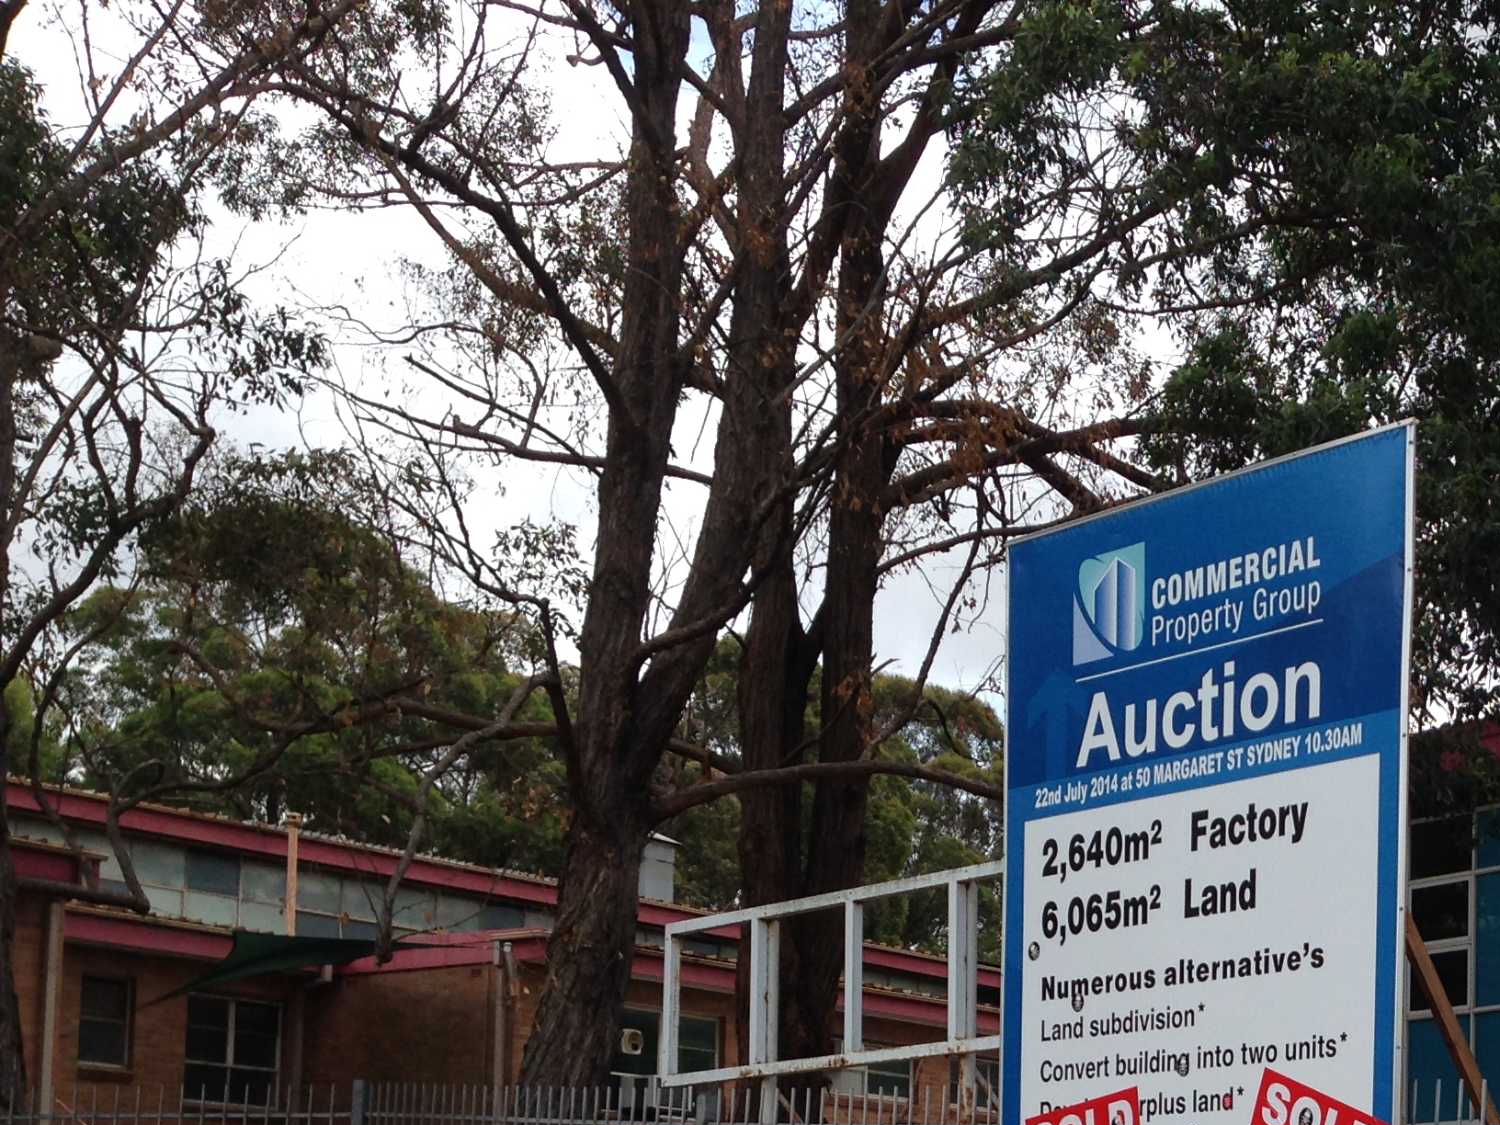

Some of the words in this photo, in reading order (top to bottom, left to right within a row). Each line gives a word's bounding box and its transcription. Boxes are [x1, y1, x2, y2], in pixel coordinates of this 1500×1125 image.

[1152, 536, 1321, 609] COMMERCIAL
[1152, 595, 1244, 646] Property
[1253, 580, 1321, 622] Group
[1076, 659, 1321, 768] Auction
[1035, 788, 1061, 809] 22nd
[1064, 783, 1088, 805] July
[1090, 779, 1118, 798] 2014
[1120, 777, 1133, 792] at
[1136, 773, 1150, 790] 50
[1154, 752, 1223, 784] MARGARET
[1226, 748, 1244, 771] ST
[1247, 735, 1300, 766] SYDNEY
[1304, 722, 1362, 754] 10.30AM
[1191, 802, 1308, 852] Factory
[1184, 868, 1257, 919] Land
[1041, 968, 1156, 1001] Numerous
[1041, 1012, 1084, 1042] Land
[1040, 1055, 1109, 1083] Convert
[1116, 1047, 1189, 1076] building
[1197, 1045, 1234, 1070] into
[1241, 1042, 1278, 1065] two
